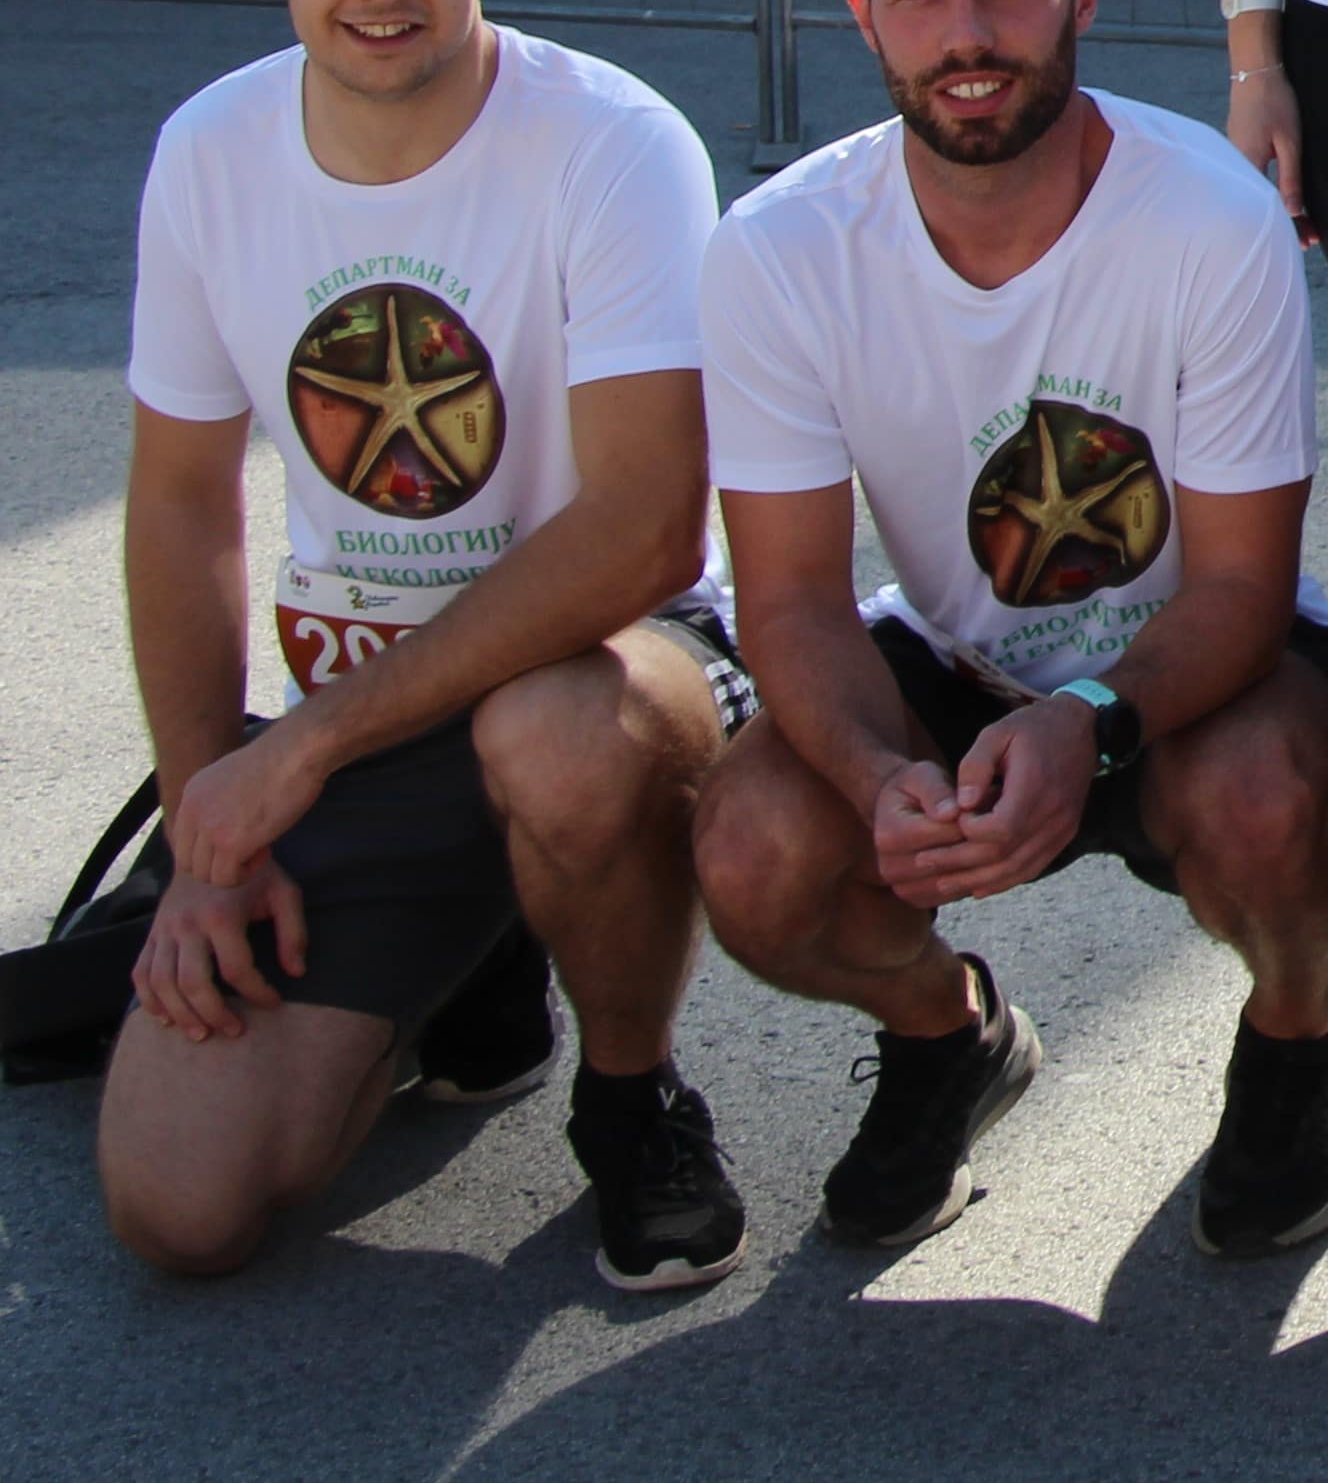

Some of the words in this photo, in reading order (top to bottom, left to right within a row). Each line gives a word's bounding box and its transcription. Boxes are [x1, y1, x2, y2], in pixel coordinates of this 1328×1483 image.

[305, 255, 445, 313] ДЕПАРТМАН
[445, 273, 473, 306] ЗА
[1093, 388, 1123, 413] ЗА
[295, 616, 412, 684] 20
